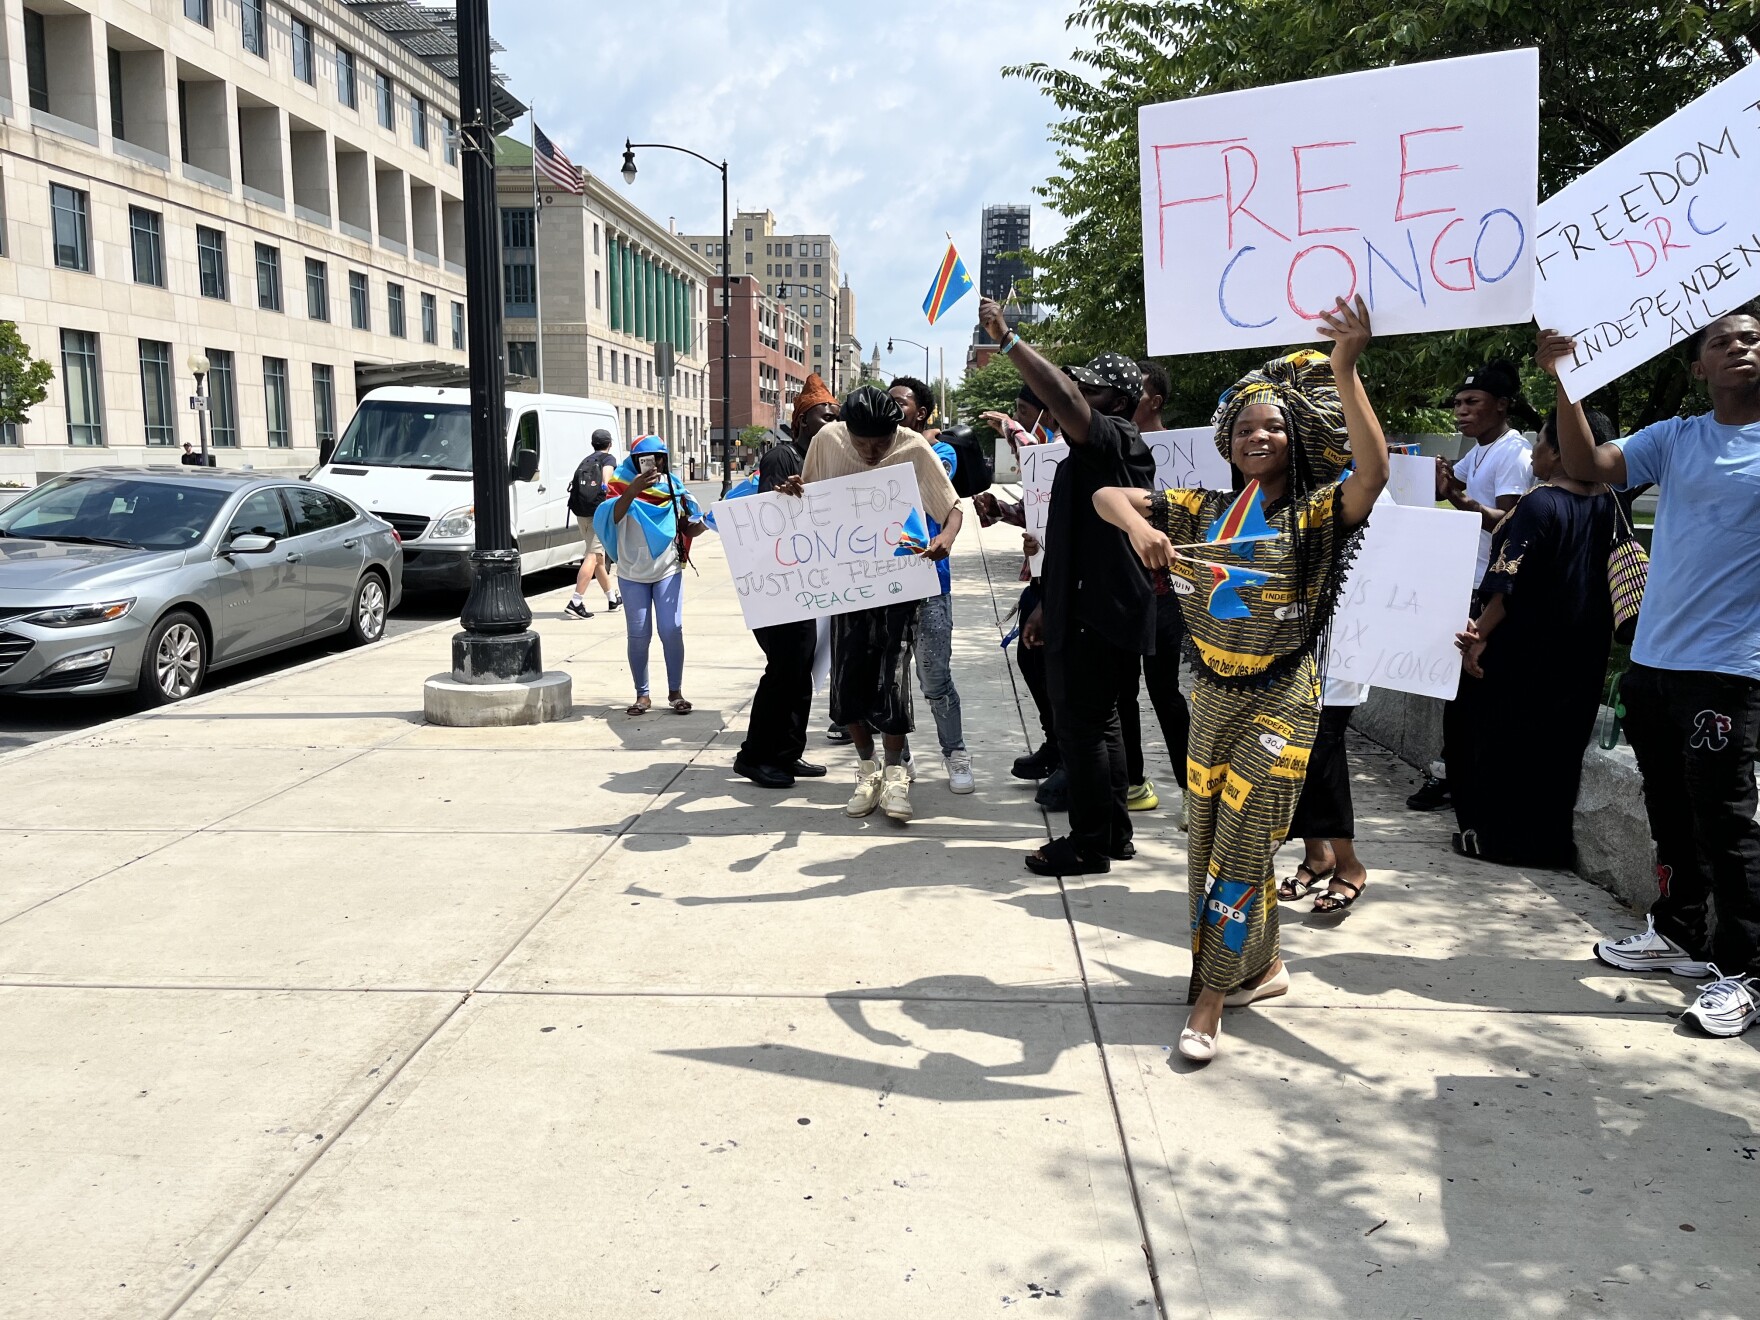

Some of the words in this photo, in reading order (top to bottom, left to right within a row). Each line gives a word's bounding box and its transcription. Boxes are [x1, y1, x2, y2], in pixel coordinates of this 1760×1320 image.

[1152, 125, 1465, 269] FREE
[1536, 126, 1741, 281] FREEDOM
[1610, 195, 1727, 278] DRC
[1218, 208, 1525, 329] CONGO
[1670, 299, 1728, 346] ALL
[728, 491, 831, 546] HOPE
[846, 479, 912, 519] FOR
[776, 521, 904, 566] CONGO
[736, 568, 830, 597] JUSTICE
[795, 584, 876, 610] PEACE
[1214, 901, 1240, 919] RDC
